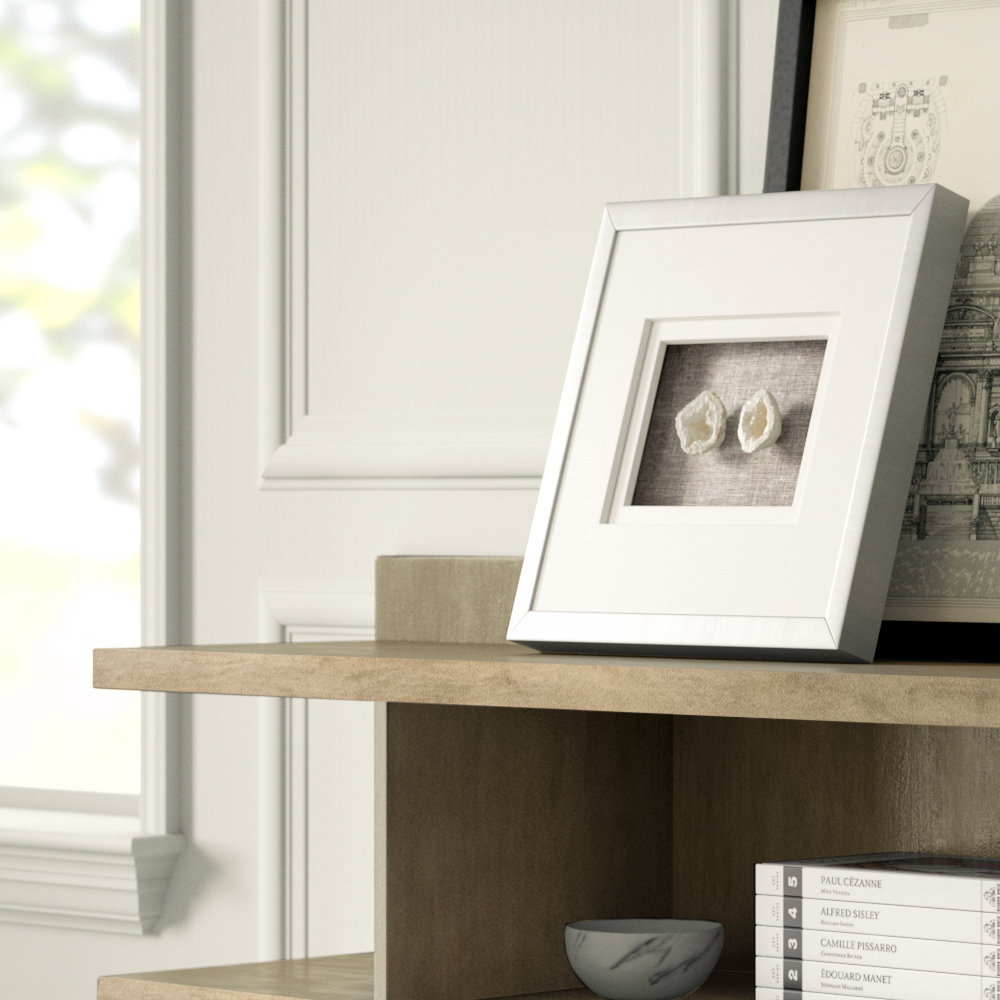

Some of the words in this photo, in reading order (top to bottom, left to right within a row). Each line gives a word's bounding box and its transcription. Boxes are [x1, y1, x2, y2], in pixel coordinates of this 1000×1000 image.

[787, 876, 798, 888] 5
[820, 875, 843, 886] PAUL
[844, 876, 883, 889] CÉZANNE
[787, 907, 798, 919] 4
[820, 907, 852, 918] ALFRED
[853, 909, 880, 920] SISLEY
[787, 938, 798, 950] 3
[820, 938, 856, 950] CAMILLE
[857, 941, 897, 953] PISSARRO
[787, 969, 798, 981] 2
[820, 968, 862, 982] ÉDOUARD
[863, 973, 893, 984] MANET
